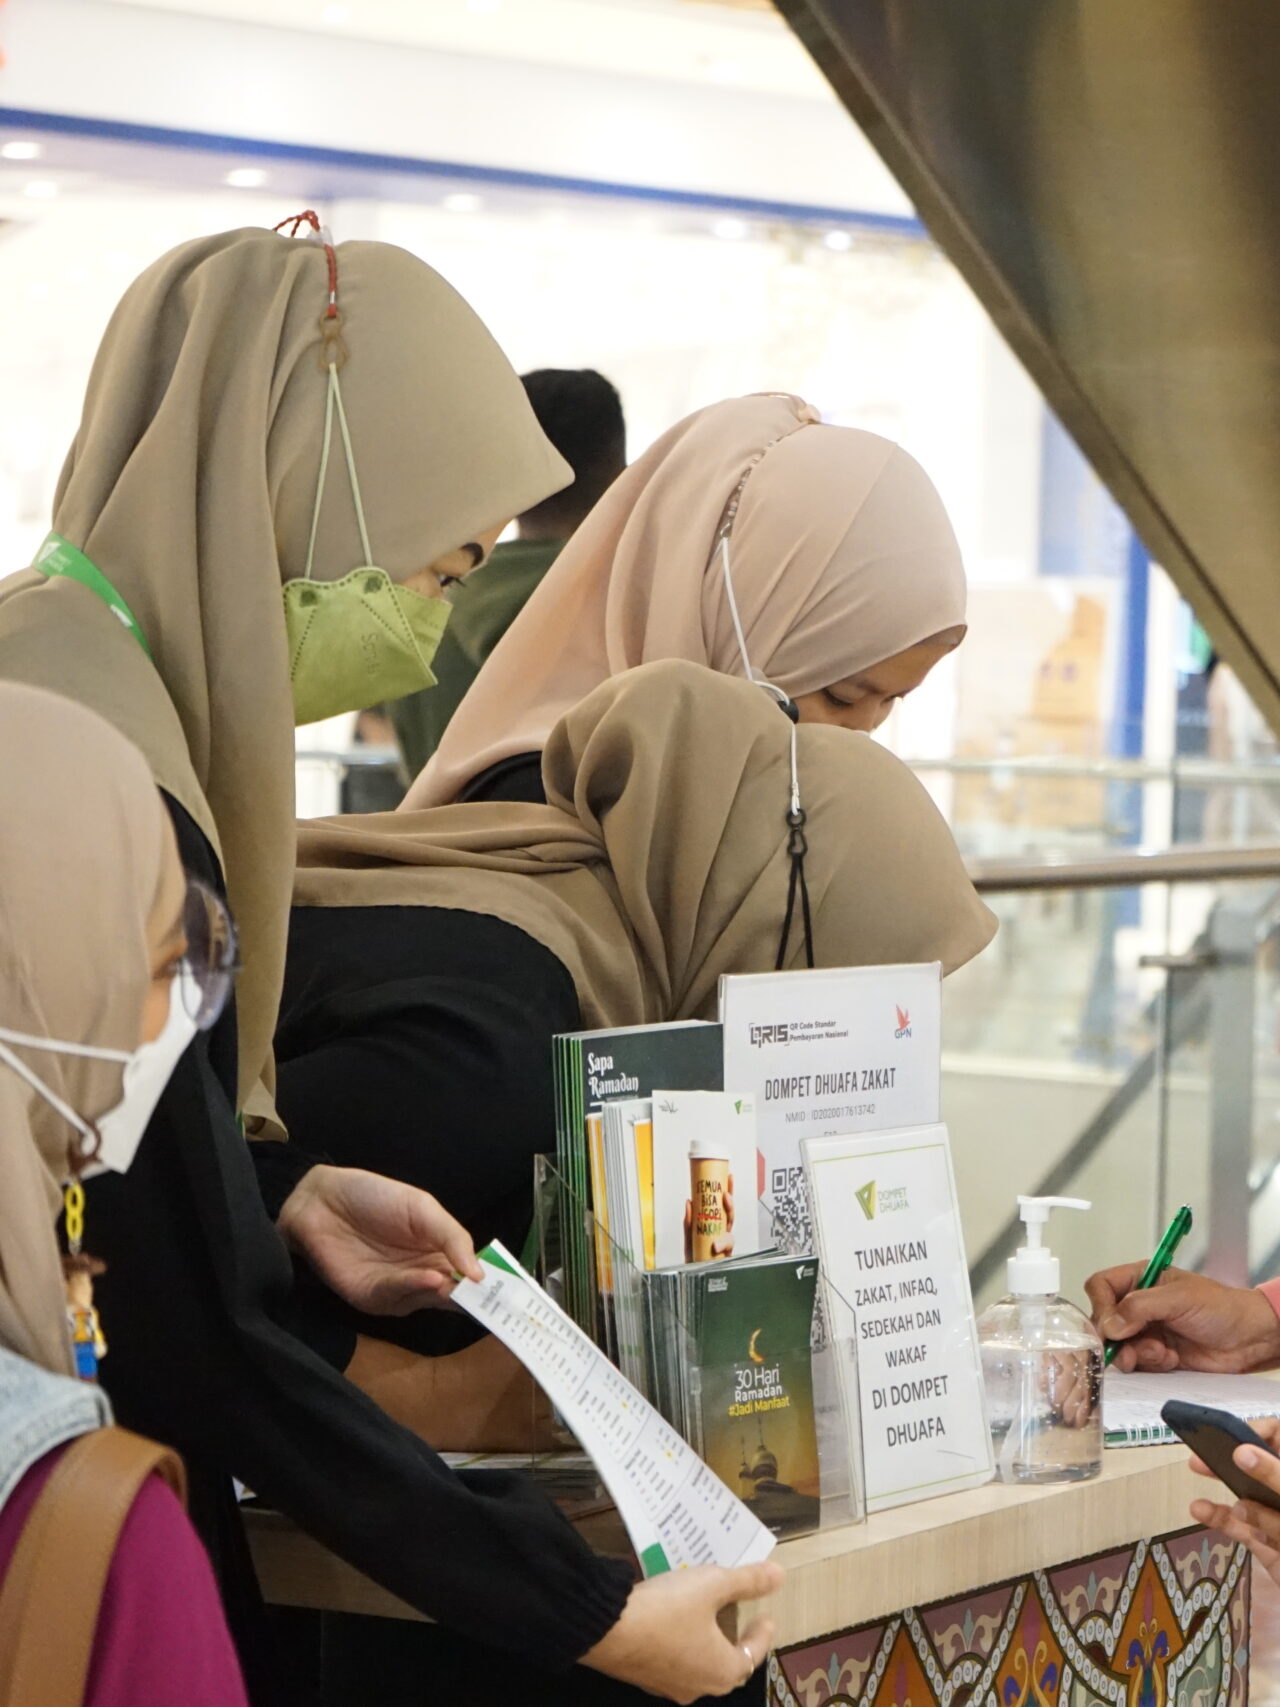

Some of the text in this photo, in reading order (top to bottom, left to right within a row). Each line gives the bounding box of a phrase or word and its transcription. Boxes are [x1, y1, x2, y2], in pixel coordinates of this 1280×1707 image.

[750, 1023, 789, 1048] QRIS
[799, 1022, 814, 1030] Code
[894, 1028, 912, 1039] GPN
[587, 1052, 614, 1077] Sapa
[588, 1072, 639, 1098] Ramadan
[765, 1067, 896, 1100] DOMPET DHUAFA ZAKAT
[785, 1111, 806, 1123] NMID
[696, 1180, 722, 1193] SEMUA
[877, 1186, 906, 1201] DOMPET
[879, 1199, 910, 1213] DHUAFA
[854, 1240, 928, 1271] TUNAIKAN
[855, 1277, 938, 1307] ZAKAT, INFAQ,
[861, 1308, 942, 1340] SEDEKAH DAN
[885, 1345, 927, 1368] WAKAF
[735, 1363, 780, 1390] 30 Hari
[734, 1385, 783, 1402] Ramadan
[872, 1375, 948, 1410] DI DOMPET
[886, 1416, 946, 1447] DHUAFA
